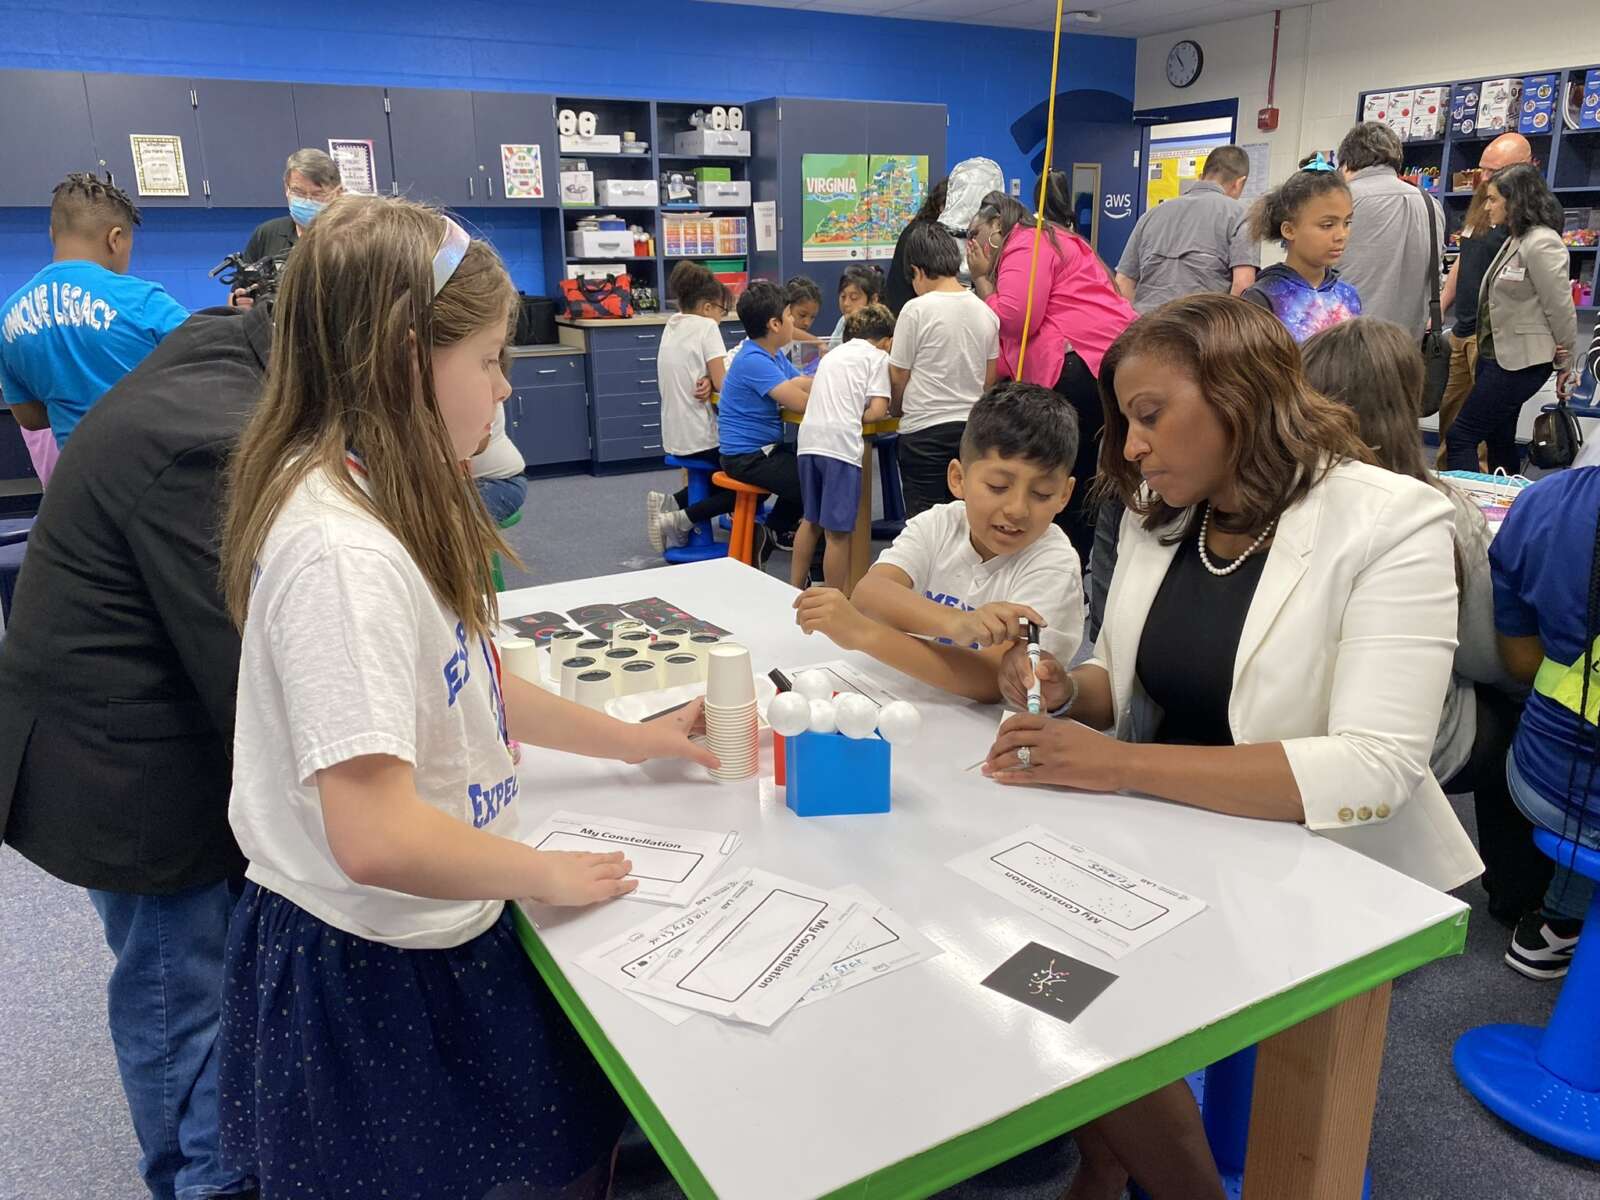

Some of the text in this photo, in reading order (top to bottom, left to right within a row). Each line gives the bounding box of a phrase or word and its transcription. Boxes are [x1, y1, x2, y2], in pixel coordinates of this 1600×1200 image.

[806, 177, 857, 193] VIRGINIA
[1105, 194, 1131, 207] aws
[2, 281, 117, 343] UNIQUE LEGACY
[580, 827, 682, 849] My Constellation
[1005, 872, 1102, 924] My Constellation
[809, 919, 829, 934] My
[758, 933, 816, 989] Constellation
